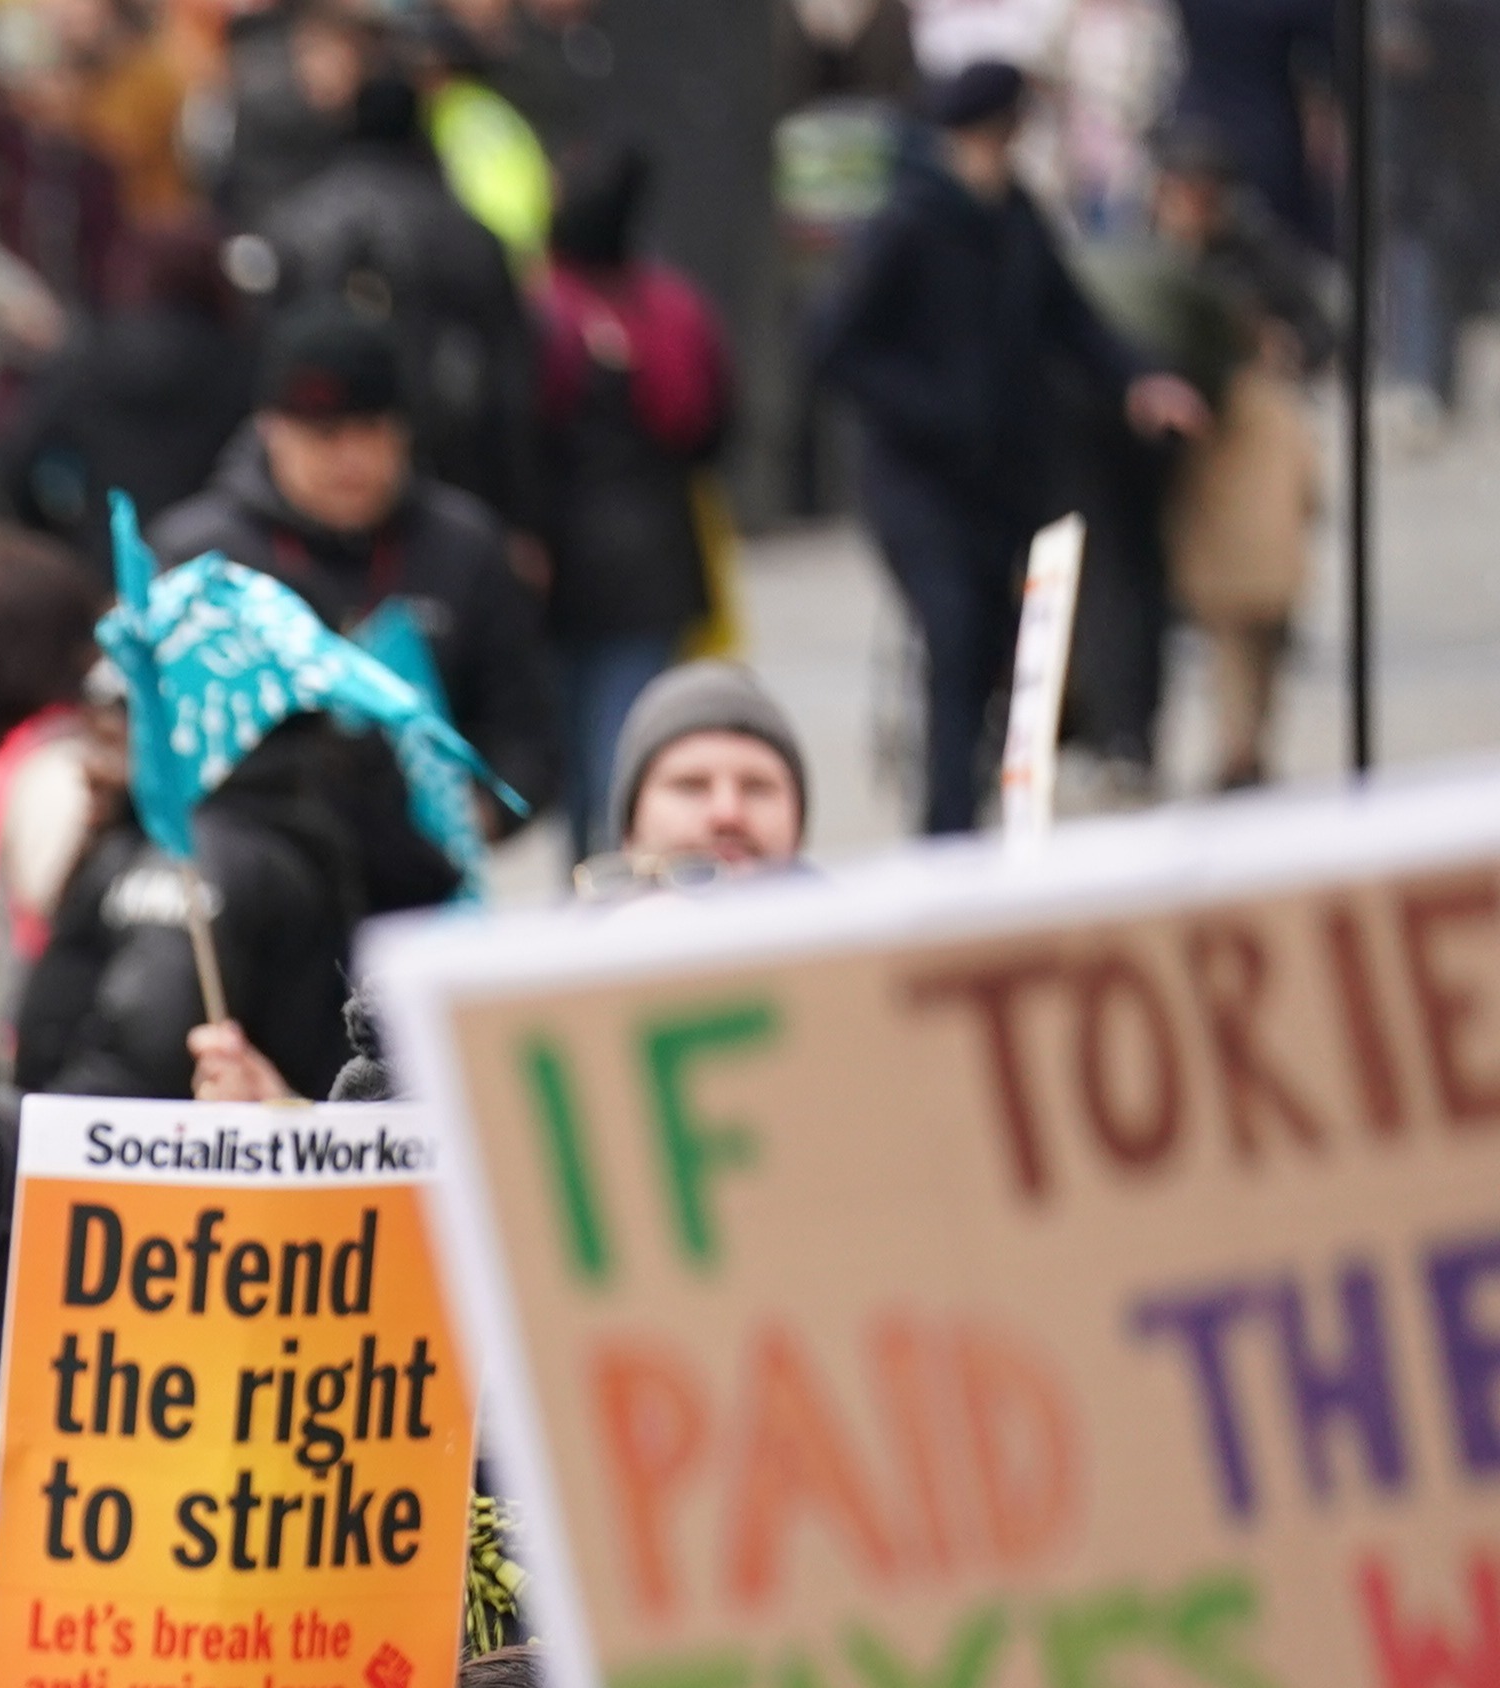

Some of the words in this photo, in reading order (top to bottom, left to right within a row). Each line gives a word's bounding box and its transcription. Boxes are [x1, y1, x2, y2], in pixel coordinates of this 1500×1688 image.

[83, 1121, 283, 1177] Socialist
[293, 1127, 440, 1174] Worke
[515, 990, 787, 1296] IF
[62, 1202, 380, 1318] Defend
[51, 1331, 195, 1442] the
[234, 1335, 438, 1471] right
[41, 1459, 133, 1564] to
[172, 1460, 422, 1573] strike
[578, 1293, 1096, 1642] PAID
[26, 1598, 133, 1658] Let's
[151, 1605, 274, 1662] break
[290, 1611, 353, 1661] the
